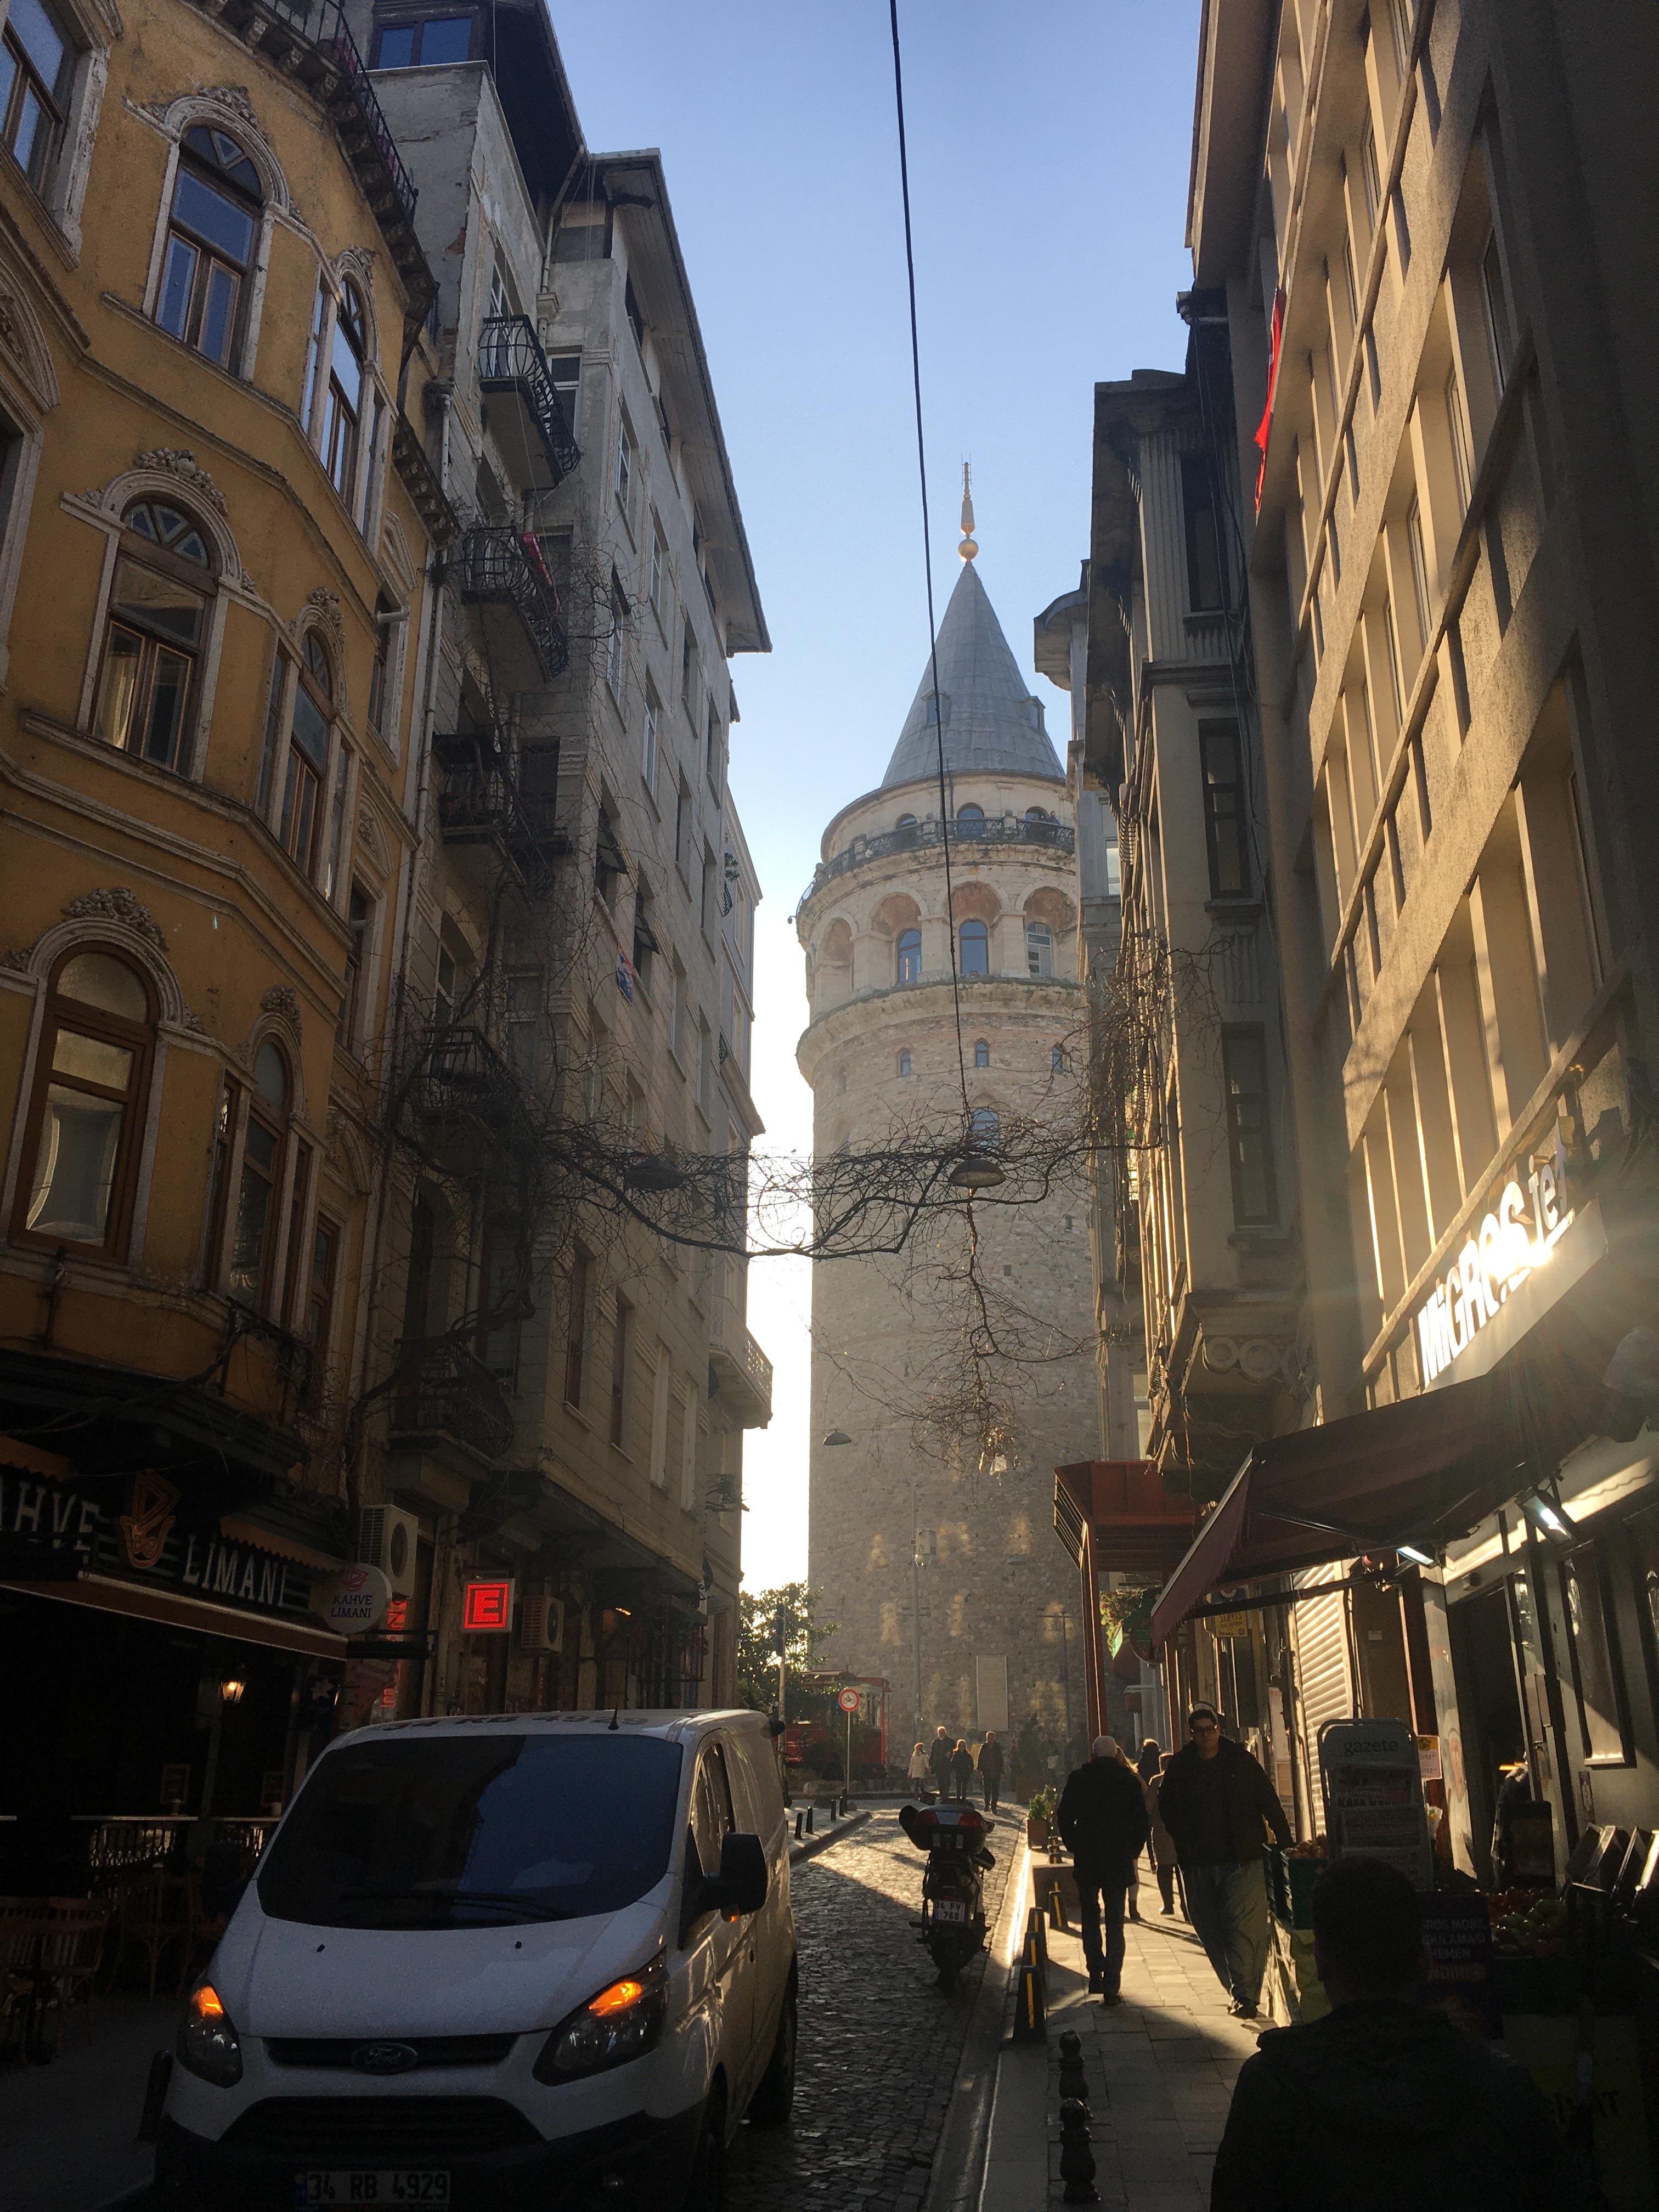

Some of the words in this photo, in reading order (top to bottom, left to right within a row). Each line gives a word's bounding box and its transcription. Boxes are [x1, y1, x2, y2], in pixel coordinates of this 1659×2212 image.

[0, 1475, 100, 1551] HVE
[333, 1594, 373, 1605] KAHVE
[473, 1589, 500, 1622] E
[330, 1605, 372, 1618] LİMANI
[1344, 1737, 1398, 1756] gazete
[364, 2047, 403, 2064] Ford
[308, 2173, 336, 2200] 34
[349, 2174, 378, 2200] RB
[393, 2173, 448, 2200] 4929
